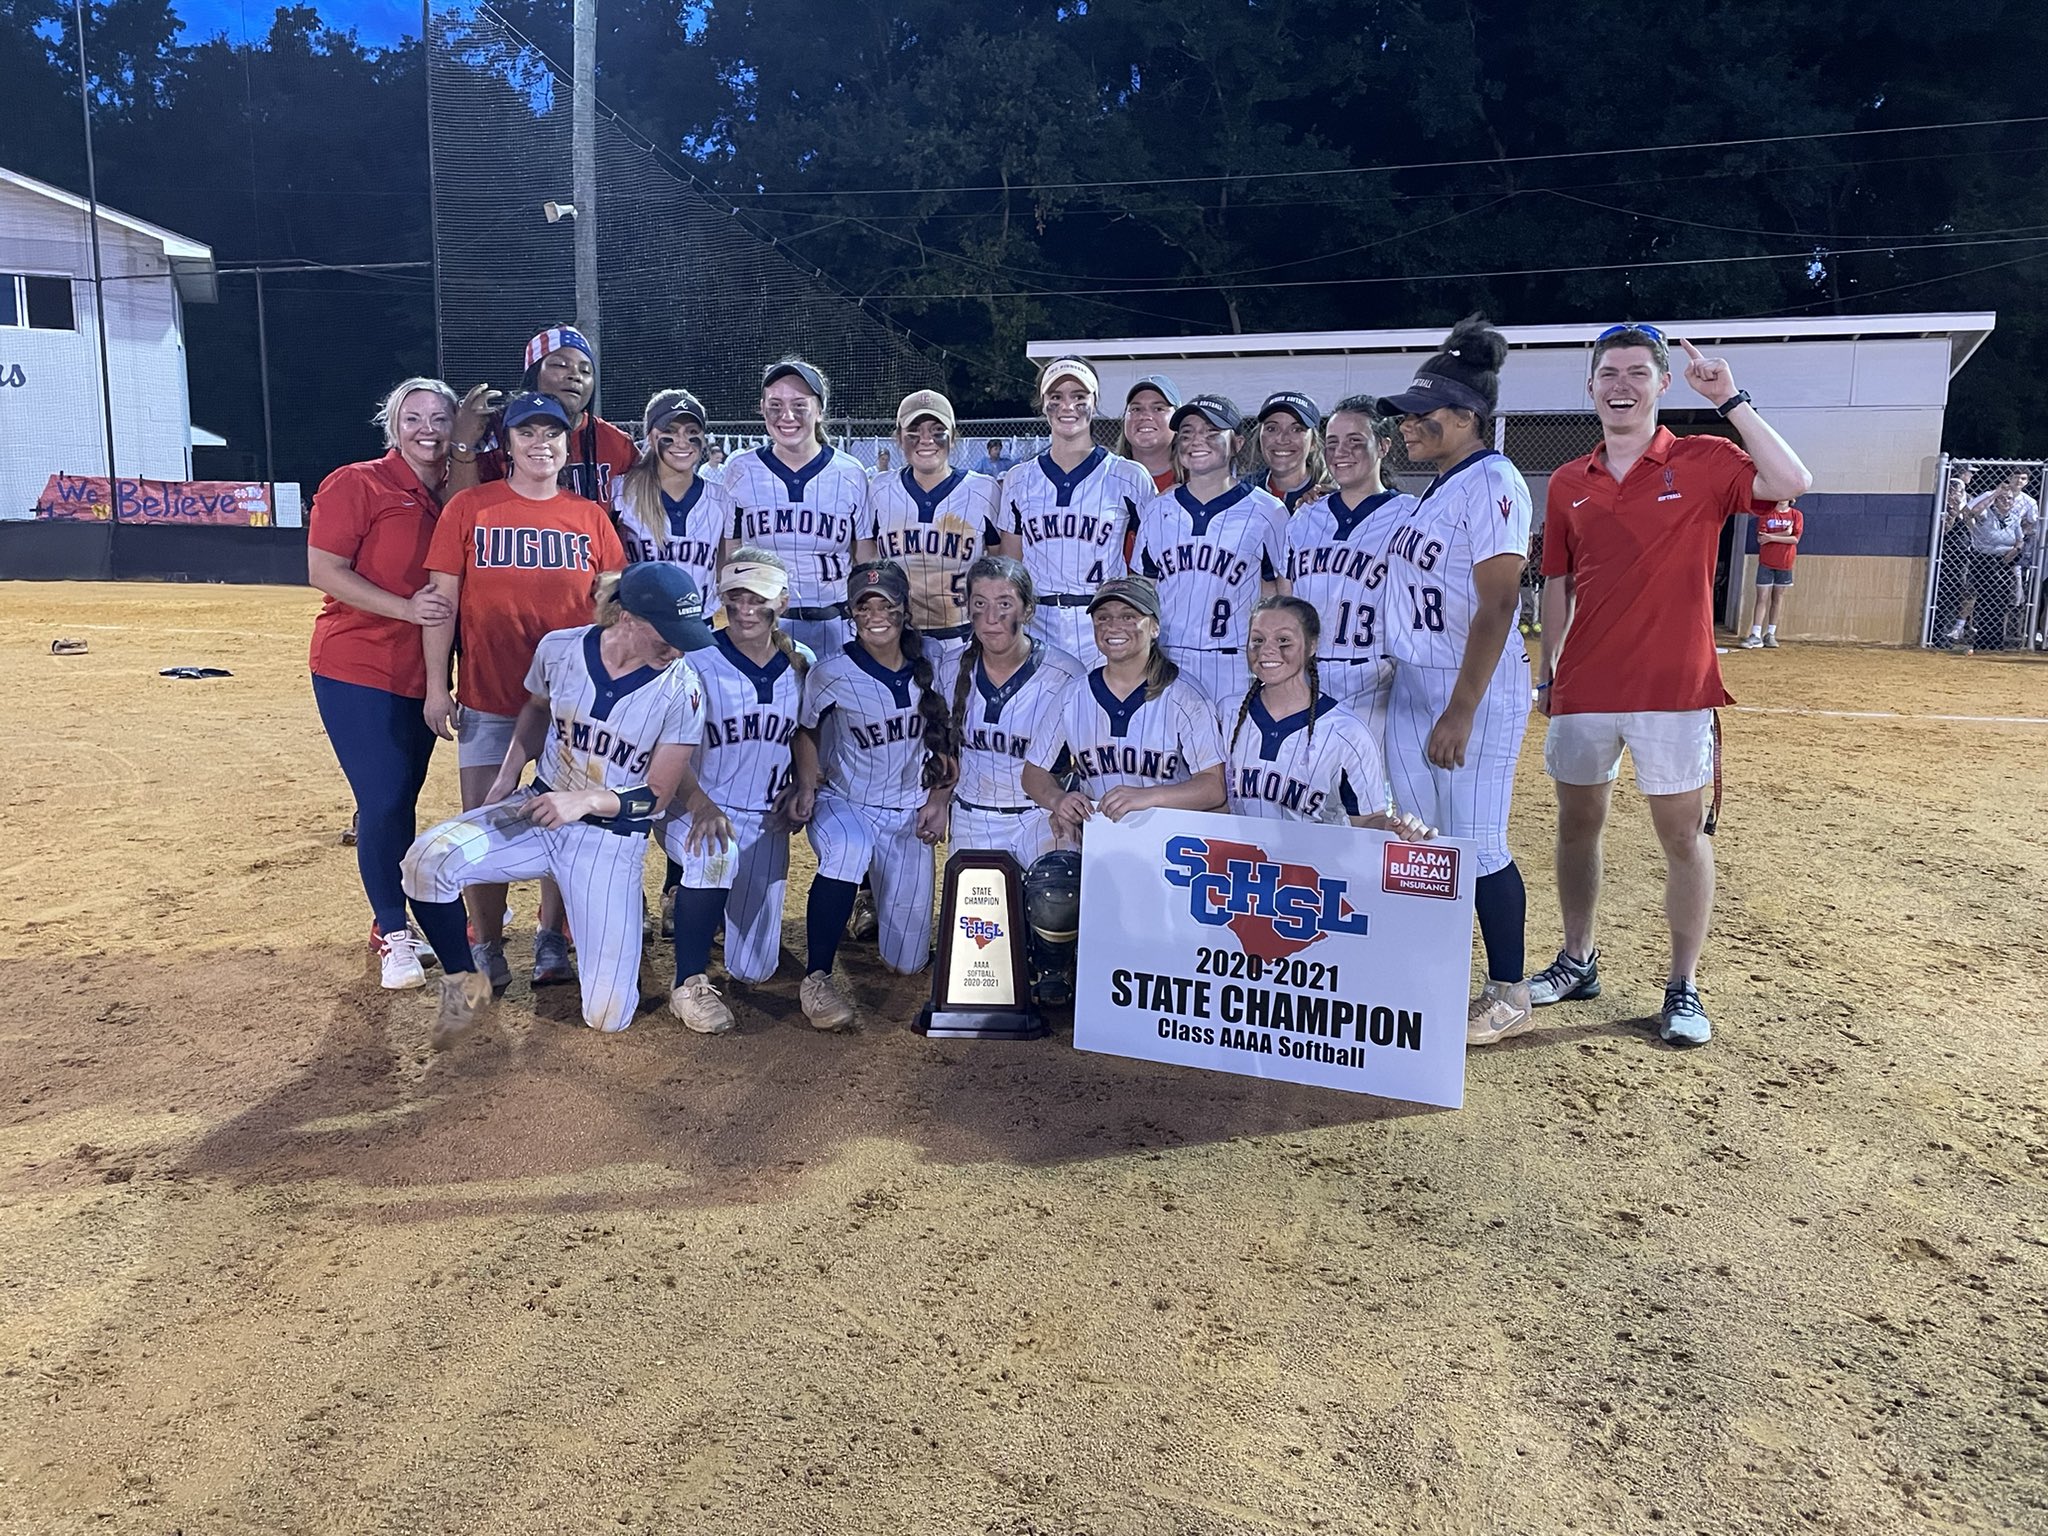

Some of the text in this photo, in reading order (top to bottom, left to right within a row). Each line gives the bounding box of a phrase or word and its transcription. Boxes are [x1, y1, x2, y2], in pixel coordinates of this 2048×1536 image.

[57, 480, 237, 518] We Believe
[746, 509, 848, 543] DEMONS
[474, 526, 592, 571] LUGOFF
[878, 529, 975, 561] DEMONS
[950, 571, 967, 608] 5
[1086, 560, 1103, 585] 4
[1210, 598, 1231, 639] 8
[1334, 600, 1376, 648] 13
[1408, 585, 1445, 632] 18
[706, 713, 796, 748] DEMON
[850, 715, 921, 750] DEMO
[1390, 862, 1451, 880] BUREAU
[1408, 850, 1451, 867] FARM
[964, 896, 1000, 906] CHAMPION
[972, 887, 992, 896] STATE
[1164, 836, 1369, 942] SCHSL
[1400, 880, 1450, 893] INSURANCE
[963, 978, 999, 987] 2020-2021
[967, 969, 996, 978] SOFTBALL
[973, 961, 990, 969] AAAA
[1196, 947, 1339, 992] 2020-2021
[1111, 968, 1423, 1051] STATE CHAMPION
[1157, 1017, 1365, 1069] Class AAAA Softball
